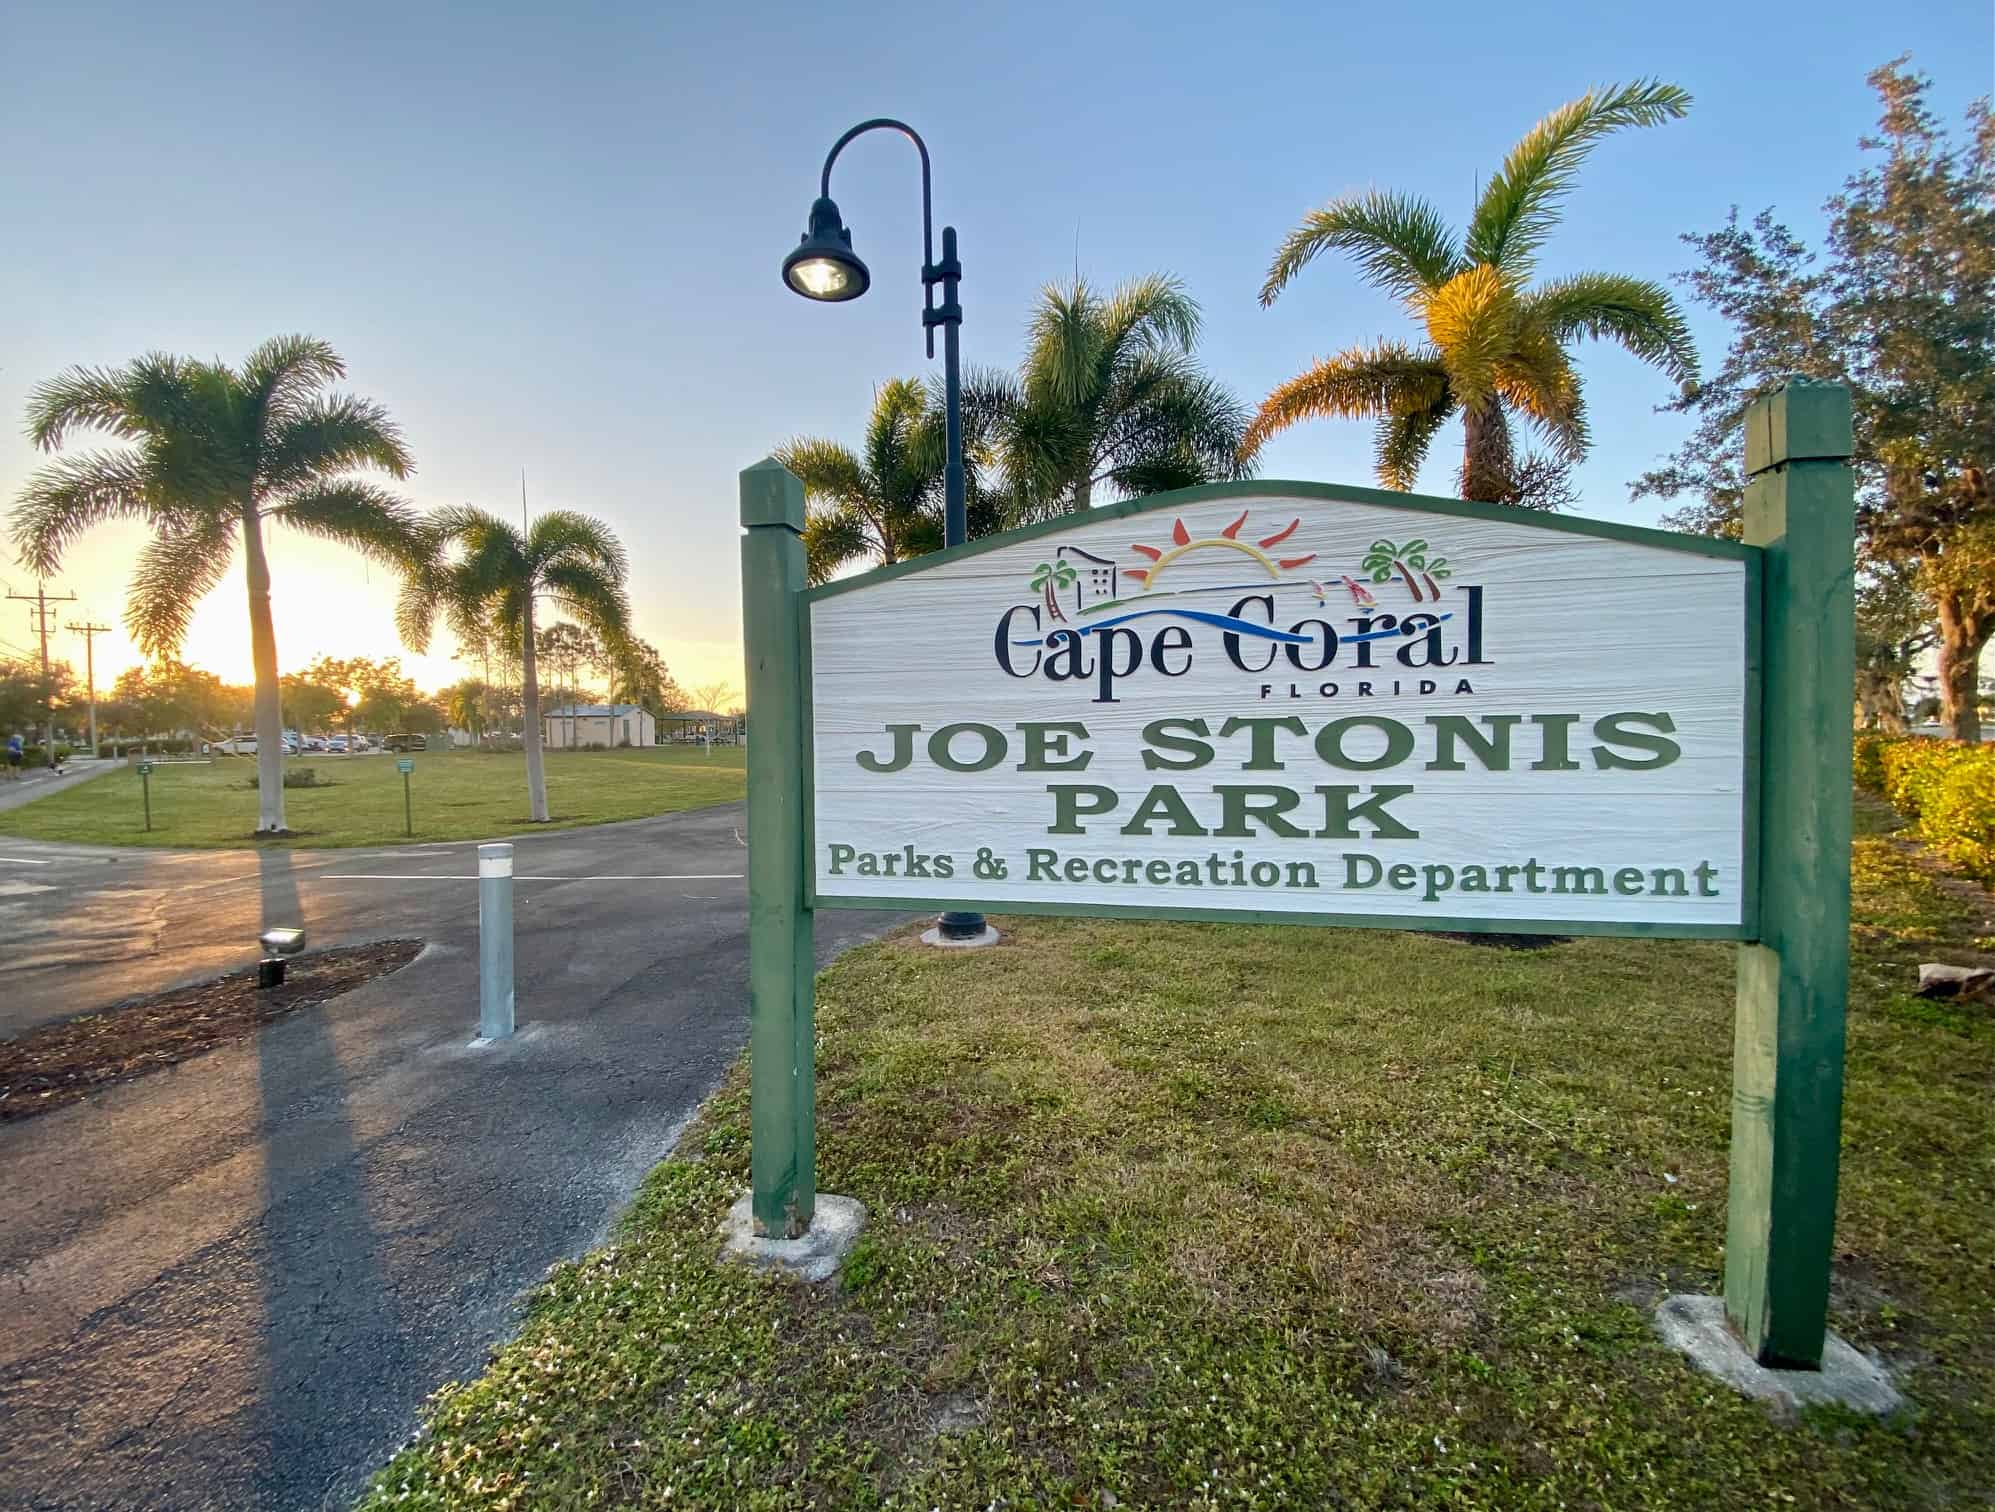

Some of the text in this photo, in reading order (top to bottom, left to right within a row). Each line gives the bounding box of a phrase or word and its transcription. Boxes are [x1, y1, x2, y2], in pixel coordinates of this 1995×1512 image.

[994, 585, 1495, 703] Cape Coral
[1260, 678, 1474, 699] FLORIDA
[855, 711, 1682, 772] JOE STONIS
[1046, 784, 1420, 840] PARK
[828, 843, 1720, 903] Parks & Recreation Department
